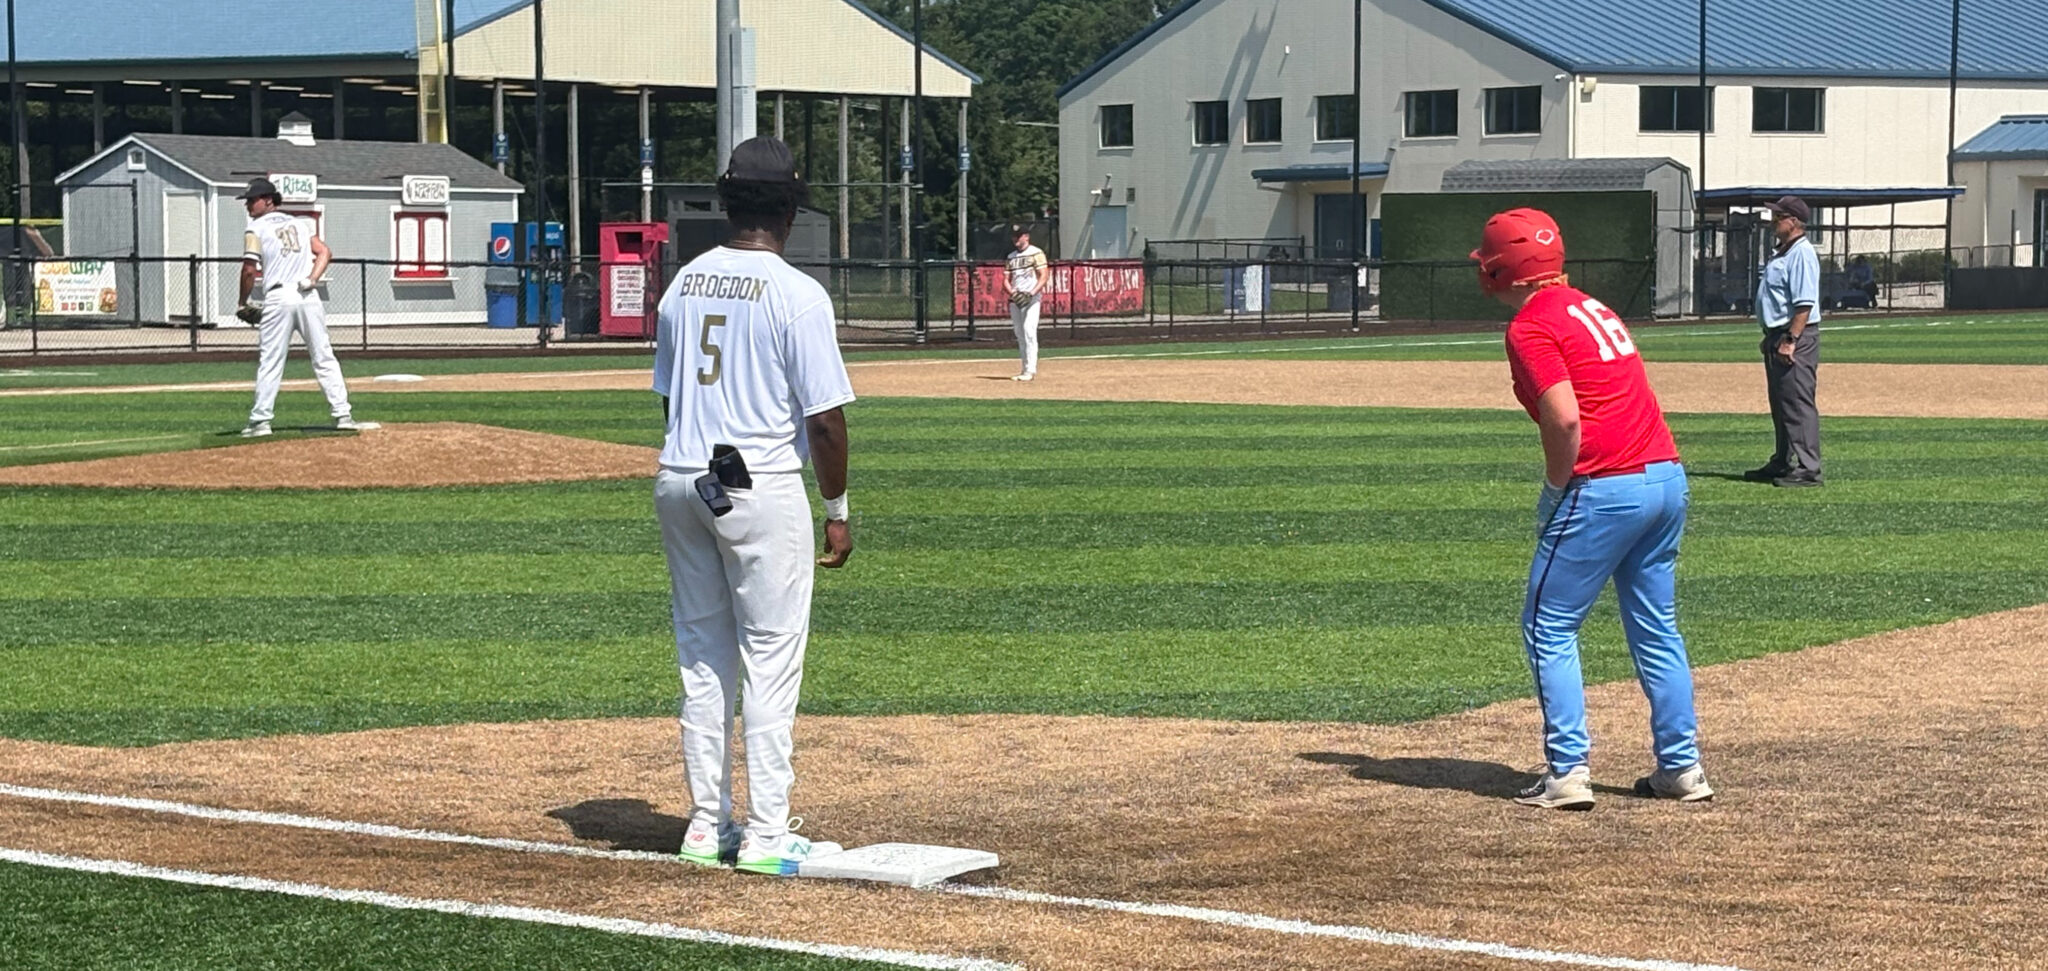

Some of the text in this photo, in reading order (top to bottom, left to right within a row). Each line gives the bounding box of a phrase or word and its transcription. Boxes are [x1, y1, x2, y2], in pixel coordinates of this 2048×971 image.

[282, 176, 313, 195] Rita's
[680, 273, 768, 303] BROGDON
[697, 314, 727, 386] 5
[1566, 298, 1635, 362] 16
